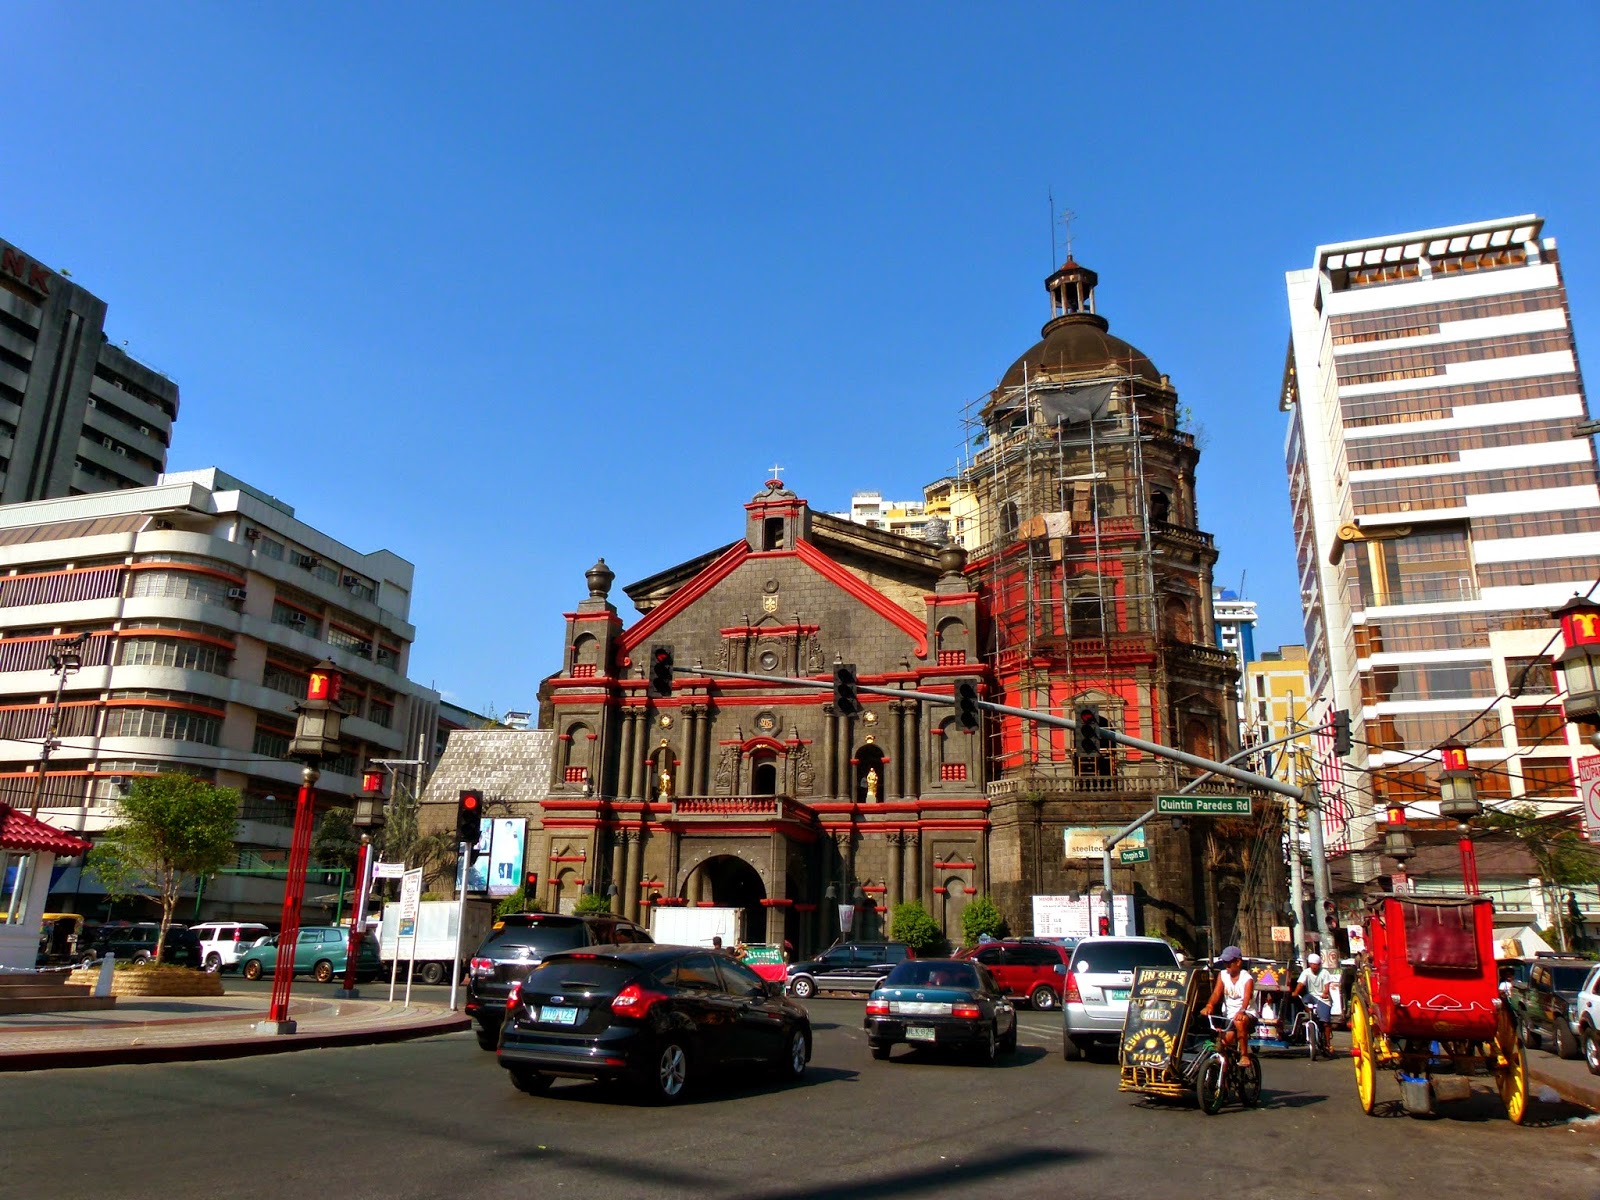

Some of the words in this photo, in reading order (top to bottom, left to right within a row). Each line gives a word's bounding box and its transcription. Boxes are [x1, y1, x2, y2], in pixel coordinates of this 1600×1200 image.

[1580, 766, 1591, 780] NO
[1160, 799, 1193, 811] Quintin
[1196, 800, 1233, 811] Paredes
[1236, 801, 1248, 811] Rd
[1122, 851, 1139, 862] Ongpin
[1139, 850, 1146, 859] St
[1138, 970, 1187, 986] KNGHTS
[1133, 1053, 1162, 1062] TAPIA
